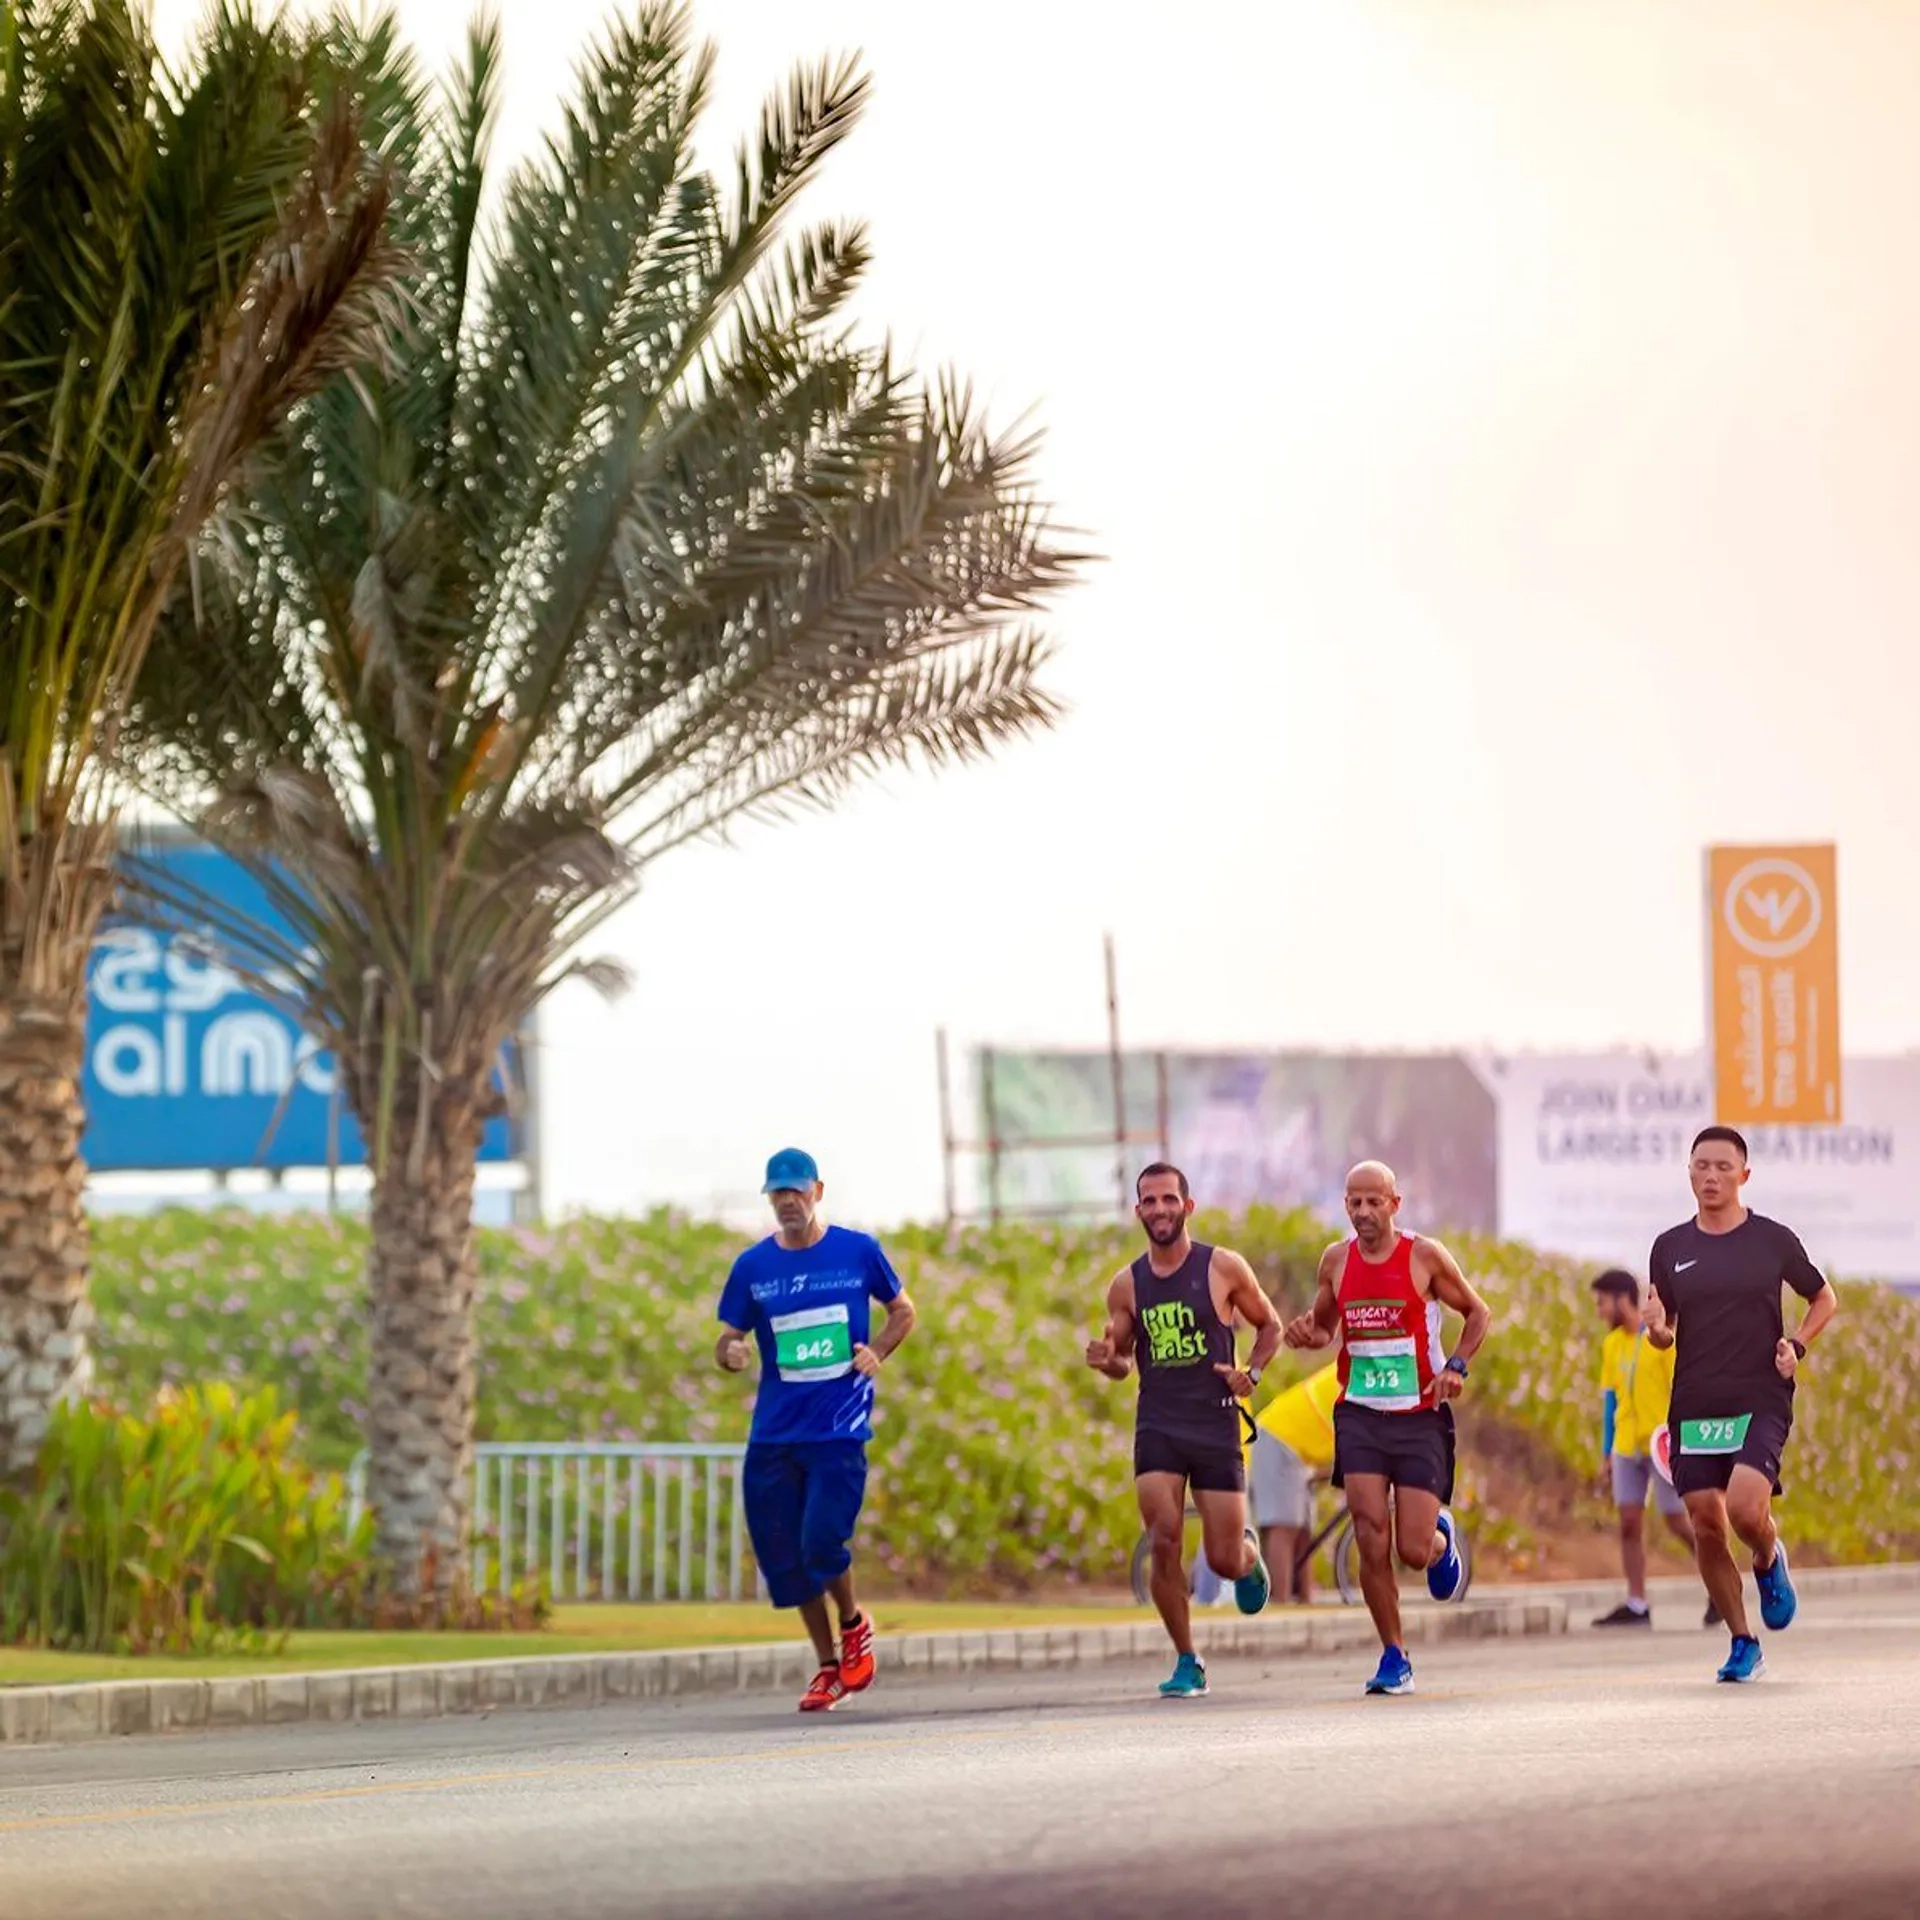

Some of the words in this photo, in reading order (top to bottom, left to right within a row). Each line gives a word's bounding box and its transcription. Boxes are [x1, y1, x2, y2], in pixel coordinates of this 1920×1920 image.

[1627, 1080, 1707, 1114] OMA
[1537, 1127, 1683, 1164] LARGEST
[1750, 1125, 1894, 1164] RATHON
[796, 1338, 834, 1361] 842
[1699, 1421, 1735, 1441] 975
